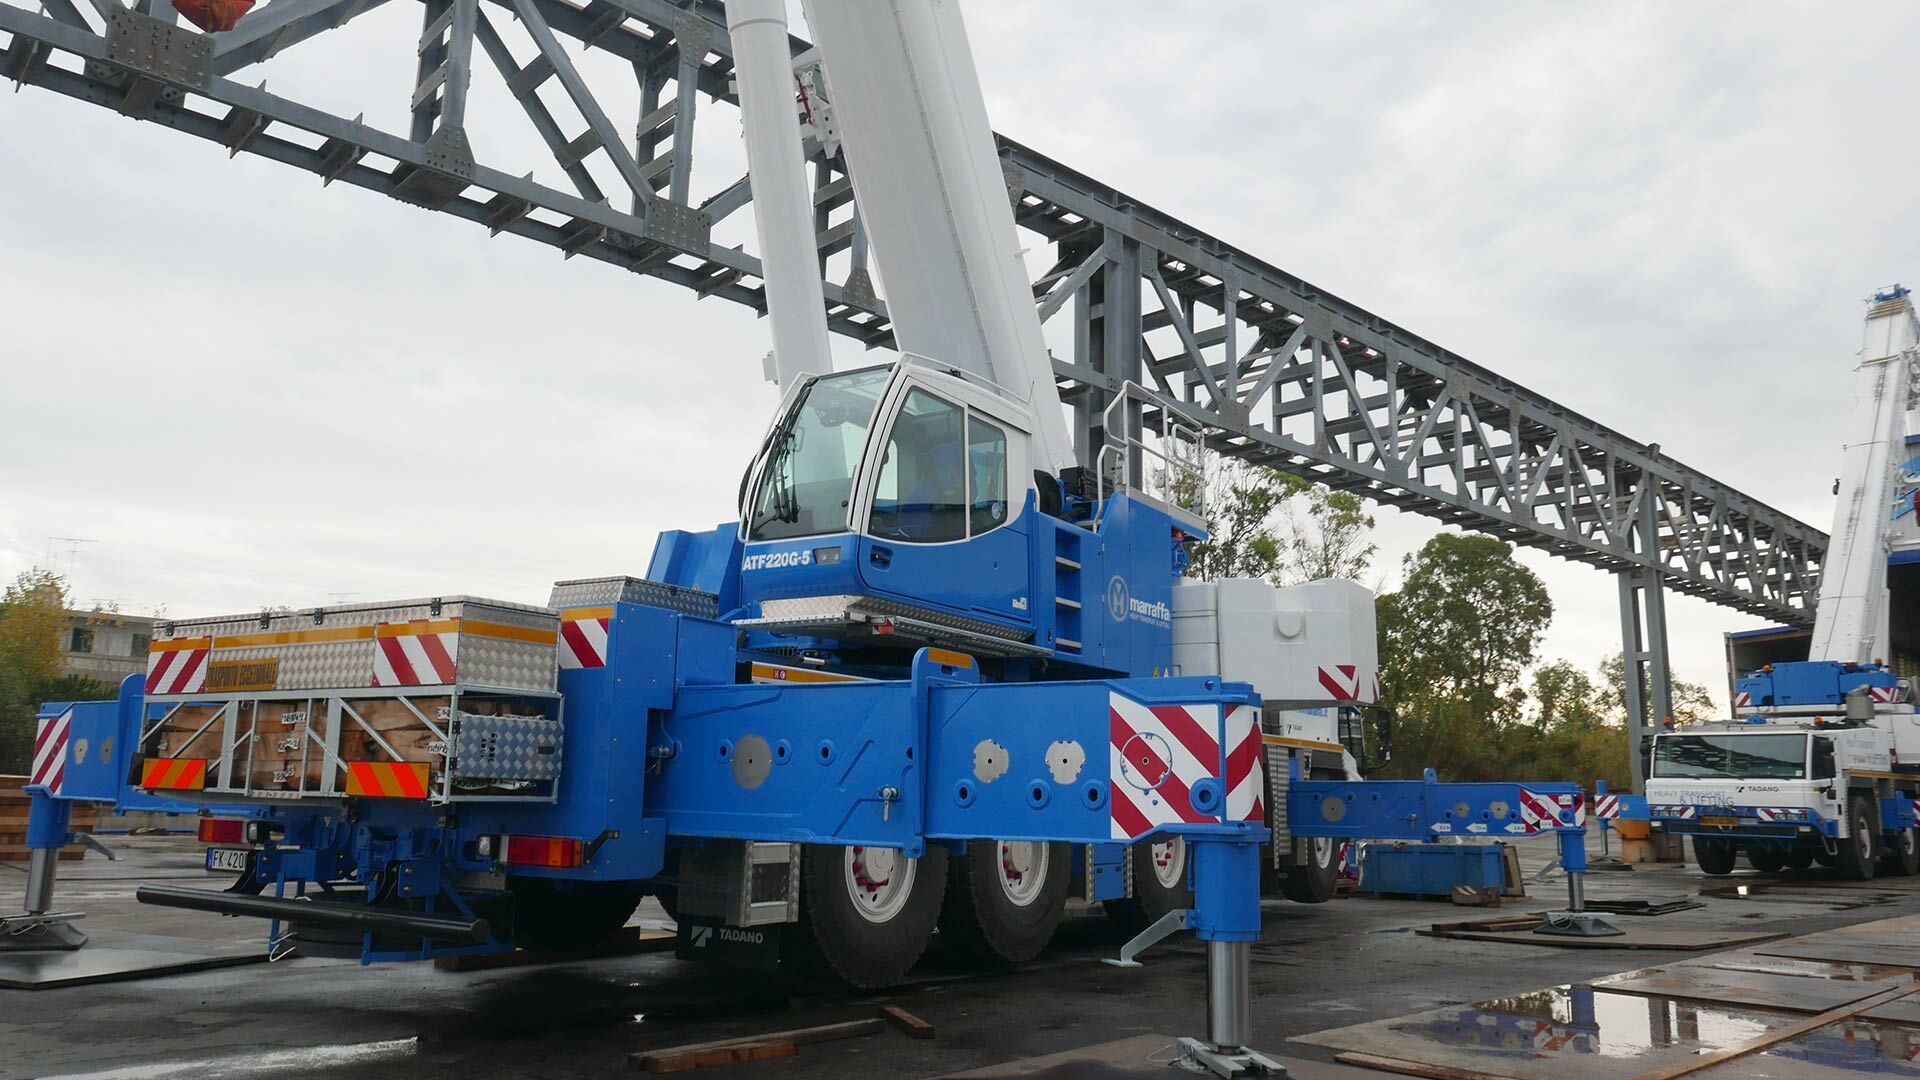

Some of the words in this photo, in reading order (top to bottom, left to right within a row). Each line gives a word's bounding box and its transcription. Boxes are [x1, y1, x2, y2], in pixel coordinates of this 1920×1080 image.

[742, 550, 811, 571] ATF220G-5
[1129, 598, 1171, 622] marraffa
[1689, 796, 1735, 806] LIFTING
[212, 850, 225, 868] FK
[226, 851, 245, 869] 420
[719, 928, 764, 944] TADANO
